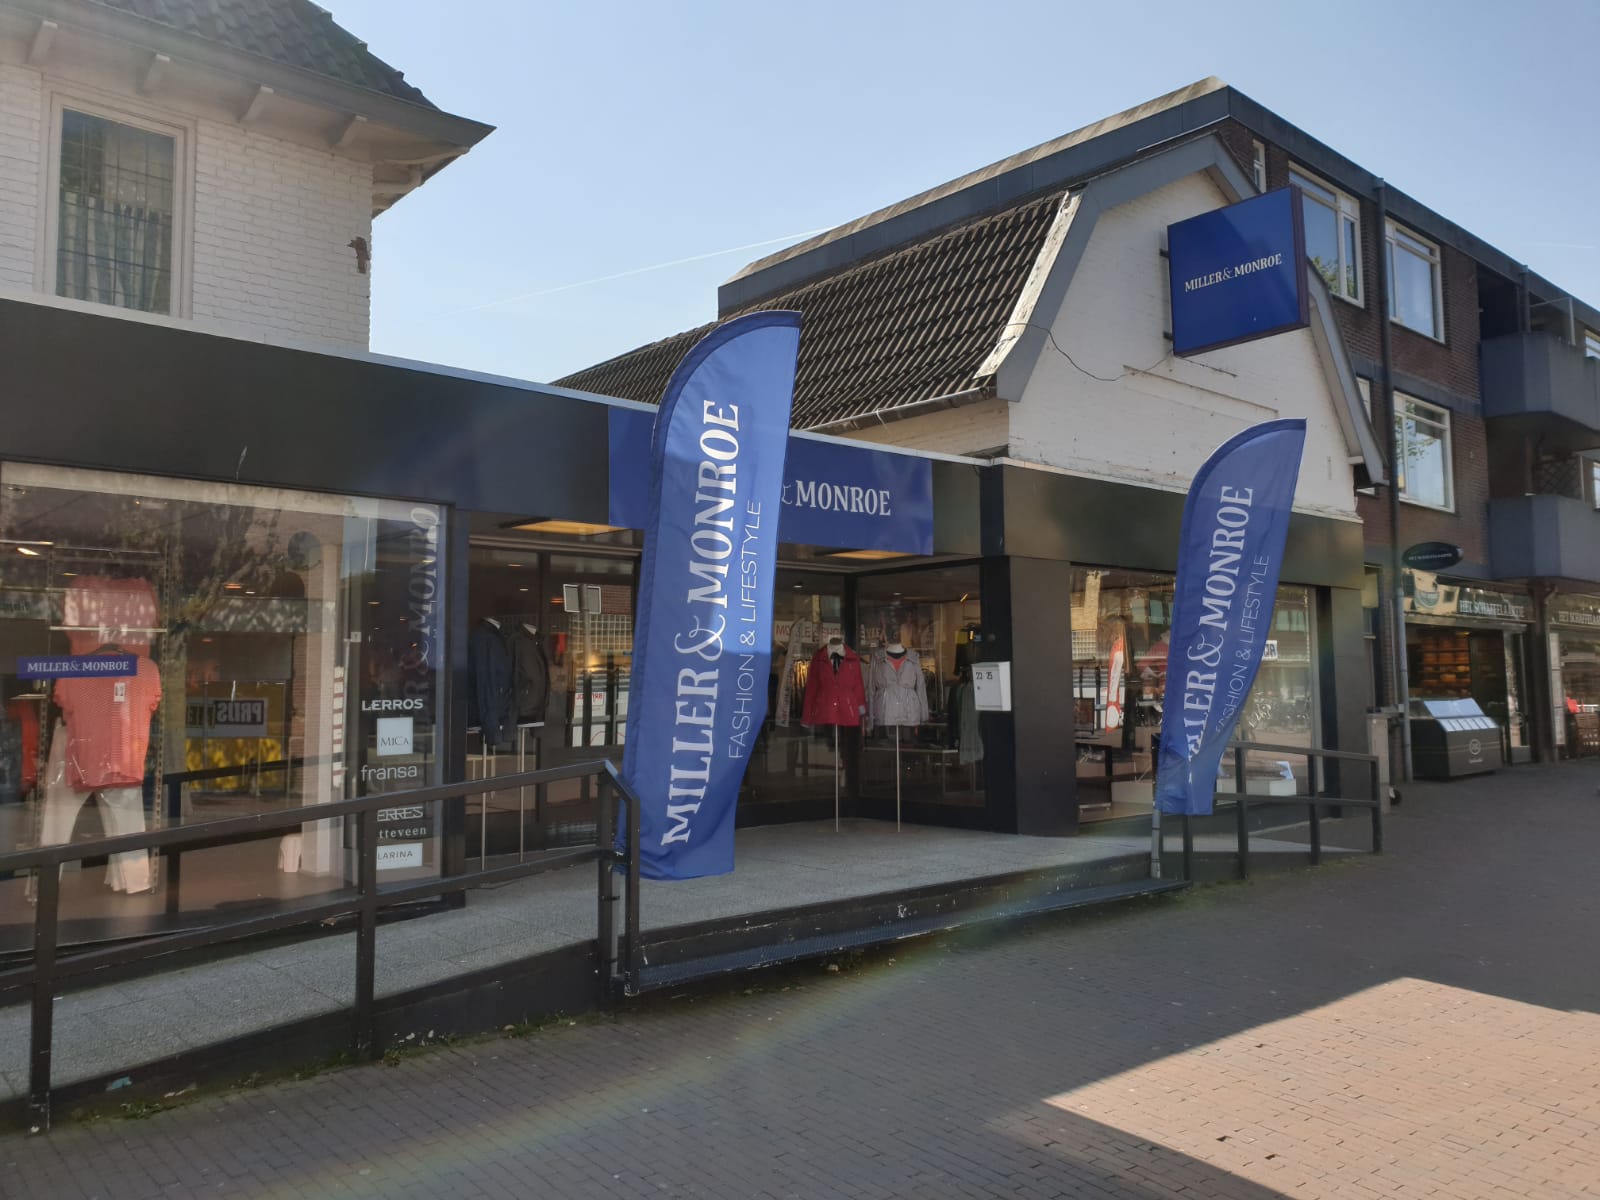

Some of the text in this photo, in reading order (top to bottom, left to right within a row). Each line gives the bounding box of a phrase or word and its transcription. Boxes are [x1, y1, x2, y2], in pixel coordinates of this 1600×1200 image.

[1234, 253, 1282, 278] MONROE
[795, 479, 891, 516] MONROE
[1239, 554, 1270, 644] LIFESTYLE
[661, 400, 739, 846] MILLER & MONROE
[728, 499, 761, 758] FASHION & LIFESTYLE
[1184, 485, 1254, 763] LLER & MONROE
[82, 660, 129, 672] MONROE
[1236, 650, 1252, 661] &
[361, 698, 424, 711] LERROS
[361, 764, 418, 781] fransa
